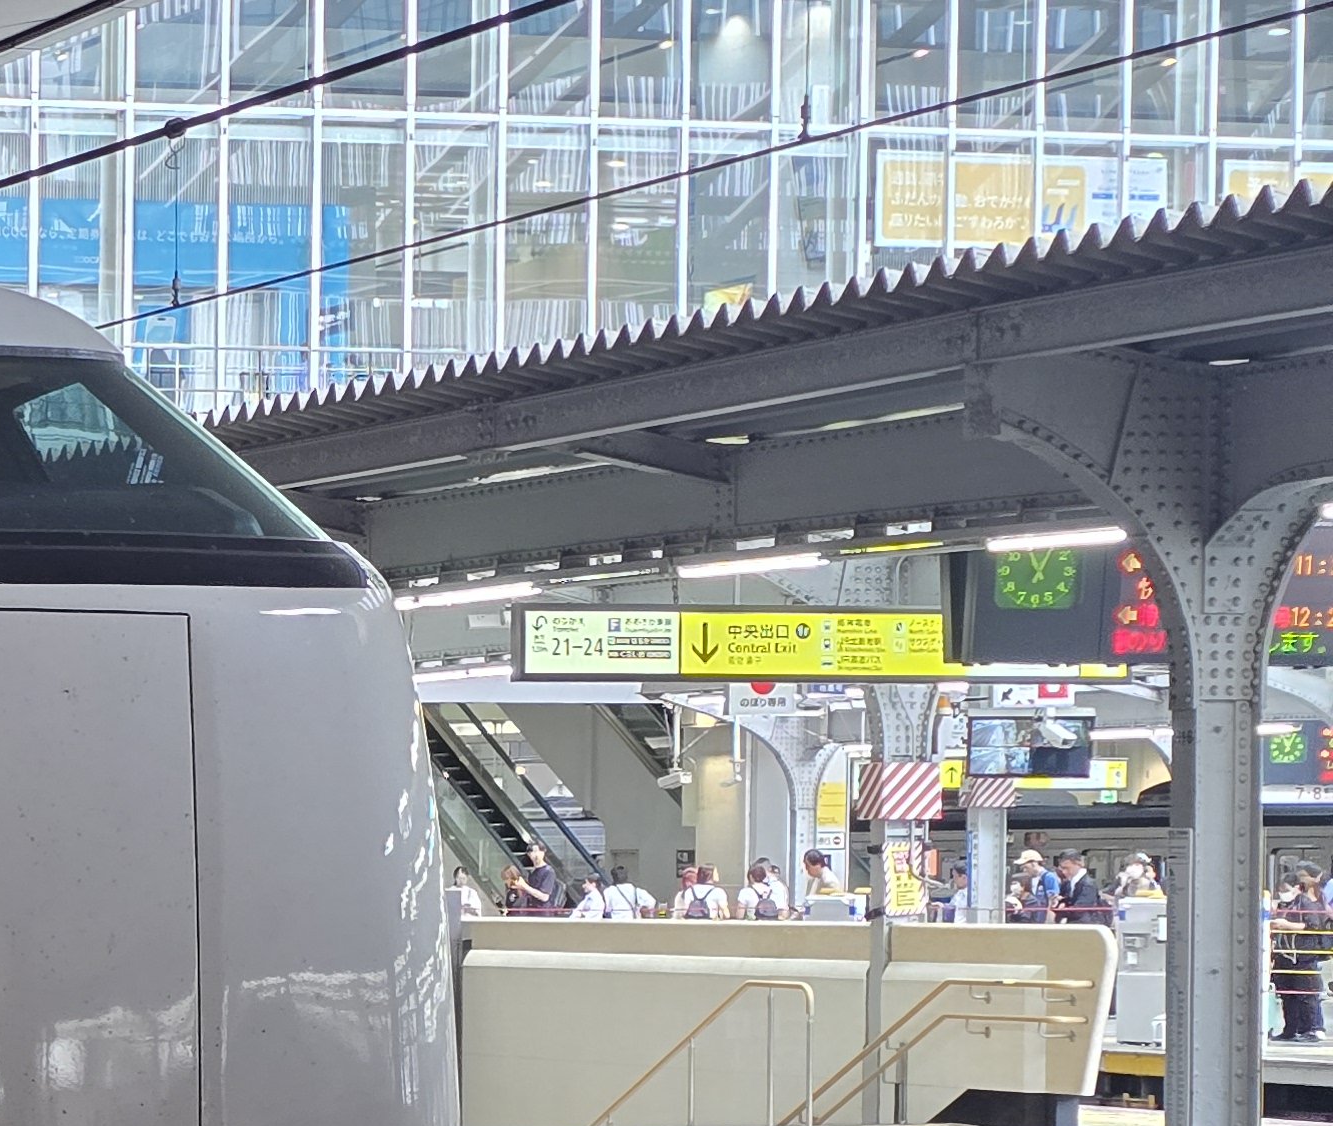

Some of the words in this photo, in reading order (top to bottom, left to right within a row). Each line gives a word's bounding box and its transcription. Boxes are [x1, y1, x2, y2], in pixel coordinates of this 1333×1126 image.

[1296, 555, 1333, 576] 11:
[728, 624, 789, 639] 中央出口
[552, 637, 603, 656] 21-24
[727, 641, 771, 653] Central
[775, 642, 797, 653] Exit
